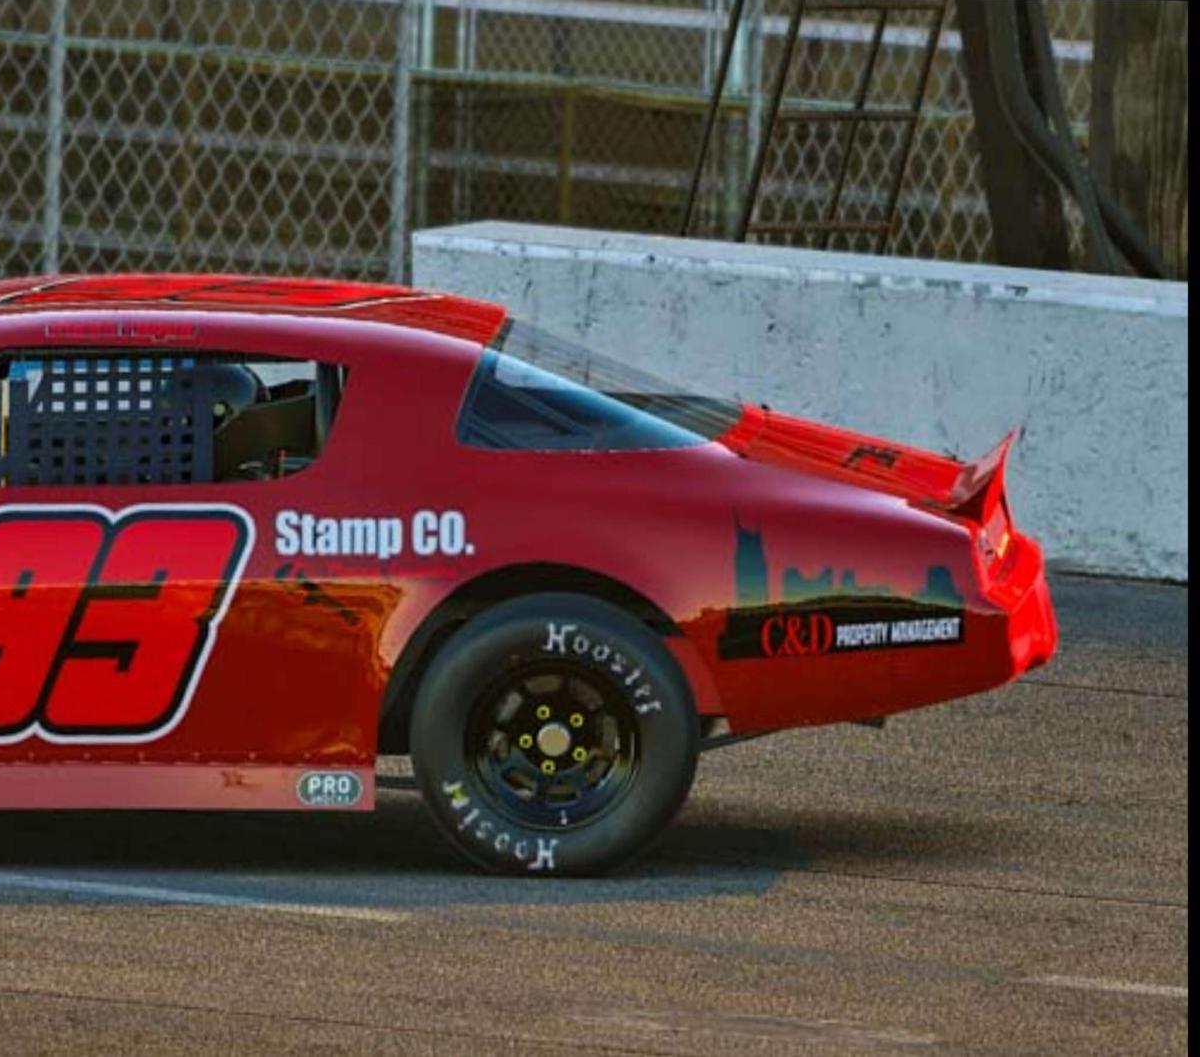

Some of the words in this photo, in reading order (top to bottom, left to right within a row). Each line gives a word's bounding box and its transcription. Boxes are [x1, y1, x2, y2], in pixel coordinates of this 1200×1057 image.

[274, 509, 403, 560] Stamp
[411, 509, 476, 556] CO.
[760, 611, 833, 657] C&D
[835, 622, 889, 647] PROPERTY
[890, 616, 961, 642] MANAGEMENT
[541, 622, 662, 714] Hoosier
[307, 775, 351, 795] PRO
